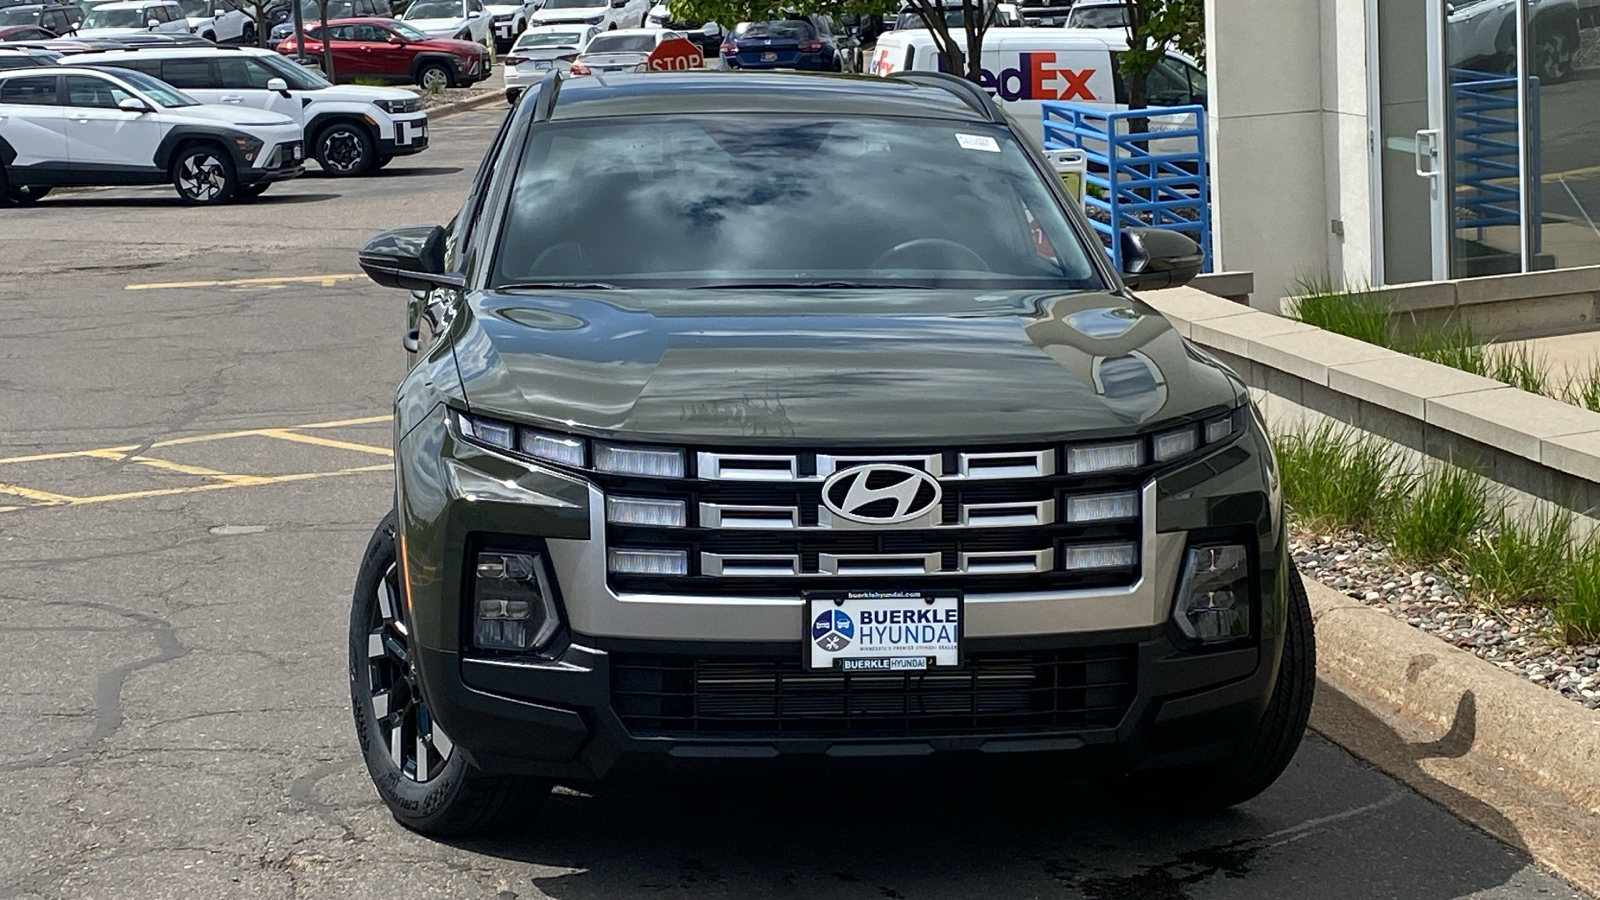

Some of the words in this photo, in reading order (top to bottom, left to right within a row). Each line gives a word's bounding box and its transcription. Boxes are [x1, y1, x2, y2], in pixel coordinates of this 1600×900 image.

[652, 54, 700, 71] STOP
[860, 609, 957, 625] BUERKLE
[860, 624, 957, 645] HYUNDAI
[844, 659, 890, 669] BUERKLE
[891, 658, 925, 668] HYUNDAI
